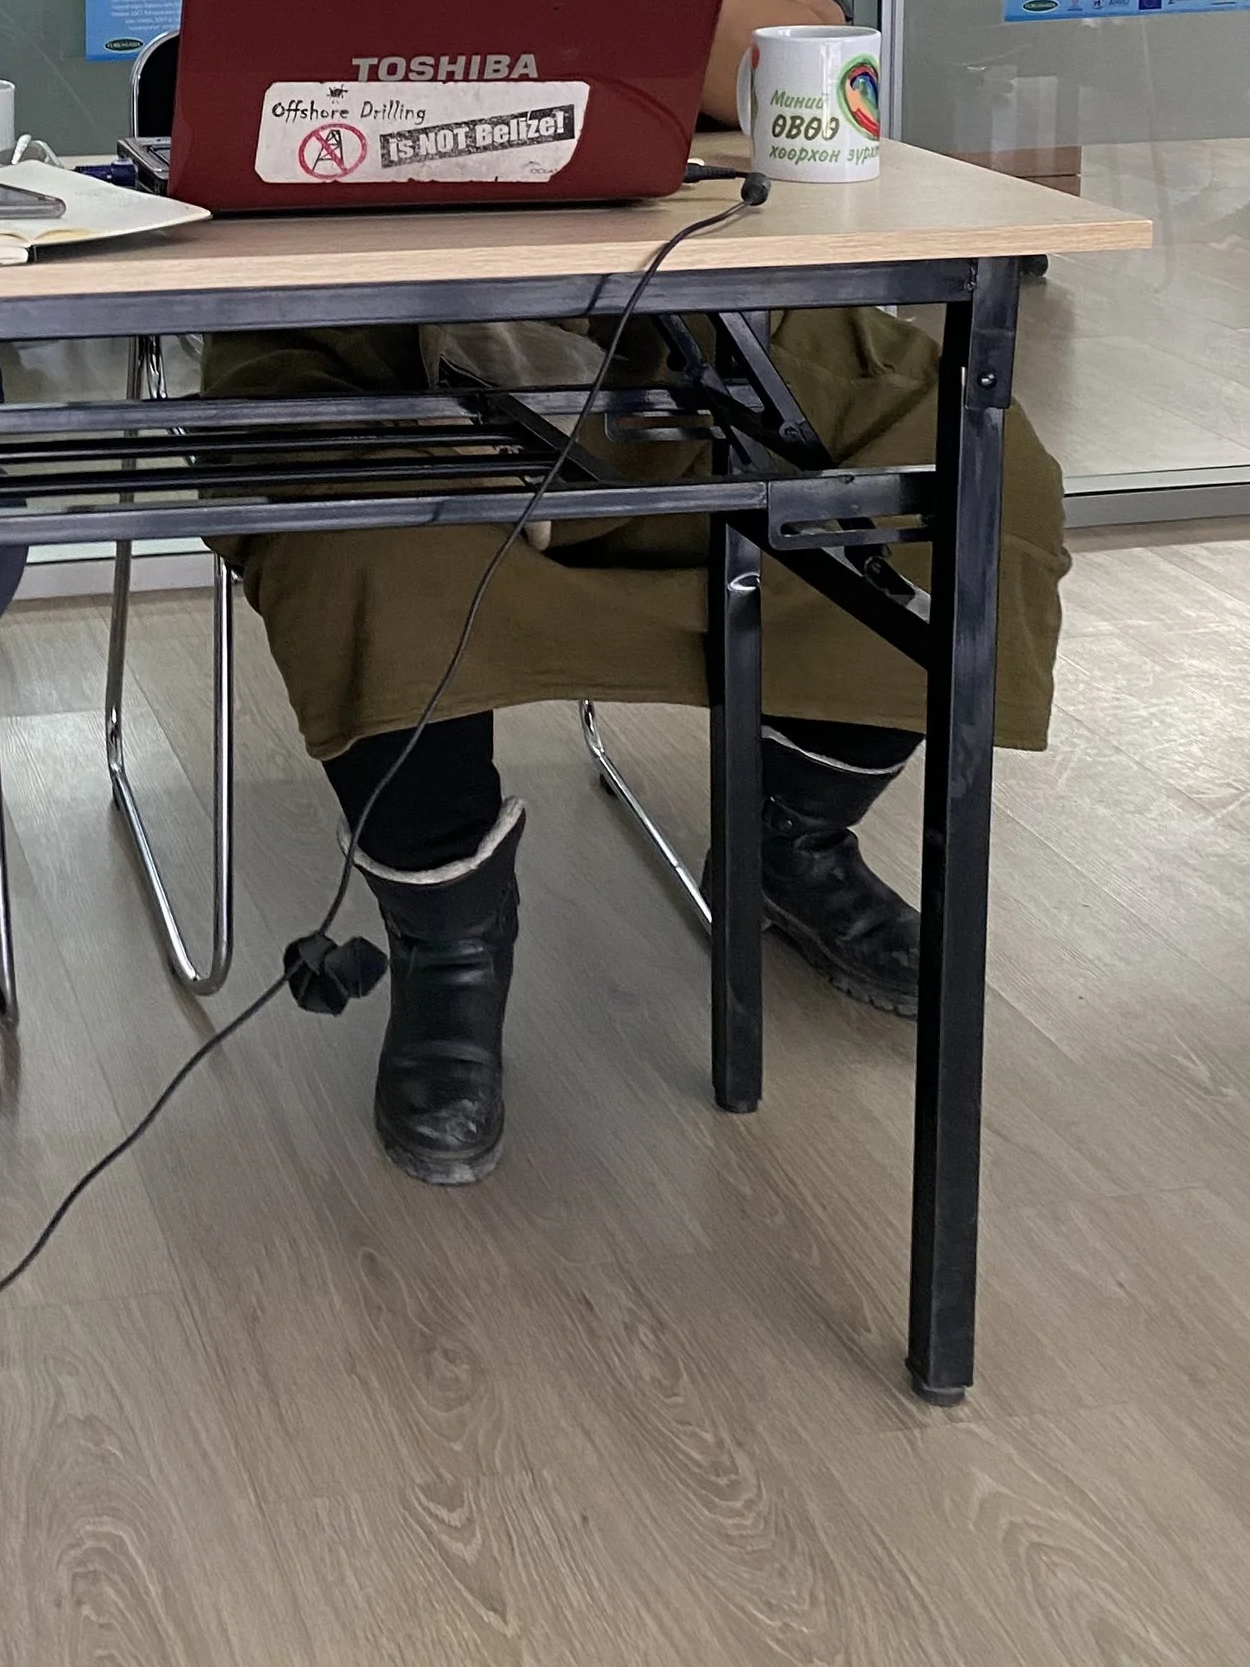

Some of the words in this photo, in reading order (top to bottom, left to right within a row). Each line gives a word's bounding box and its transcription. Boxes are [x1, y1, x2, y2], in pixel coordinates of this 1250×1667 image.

[352, 54, 540, 82] TOSHIBA
[271, 100, 350, 124] Offshore
[360, 100, 427, 126] Drilling
[389, 138, 415, 162] is
[416, 130, 468, 156] NOT
[473, 108, 566, 148] Belize!
[771, 114, 840, 141] ӨВӨӨ
[769, 145, 842, 165] хөөрхөн
